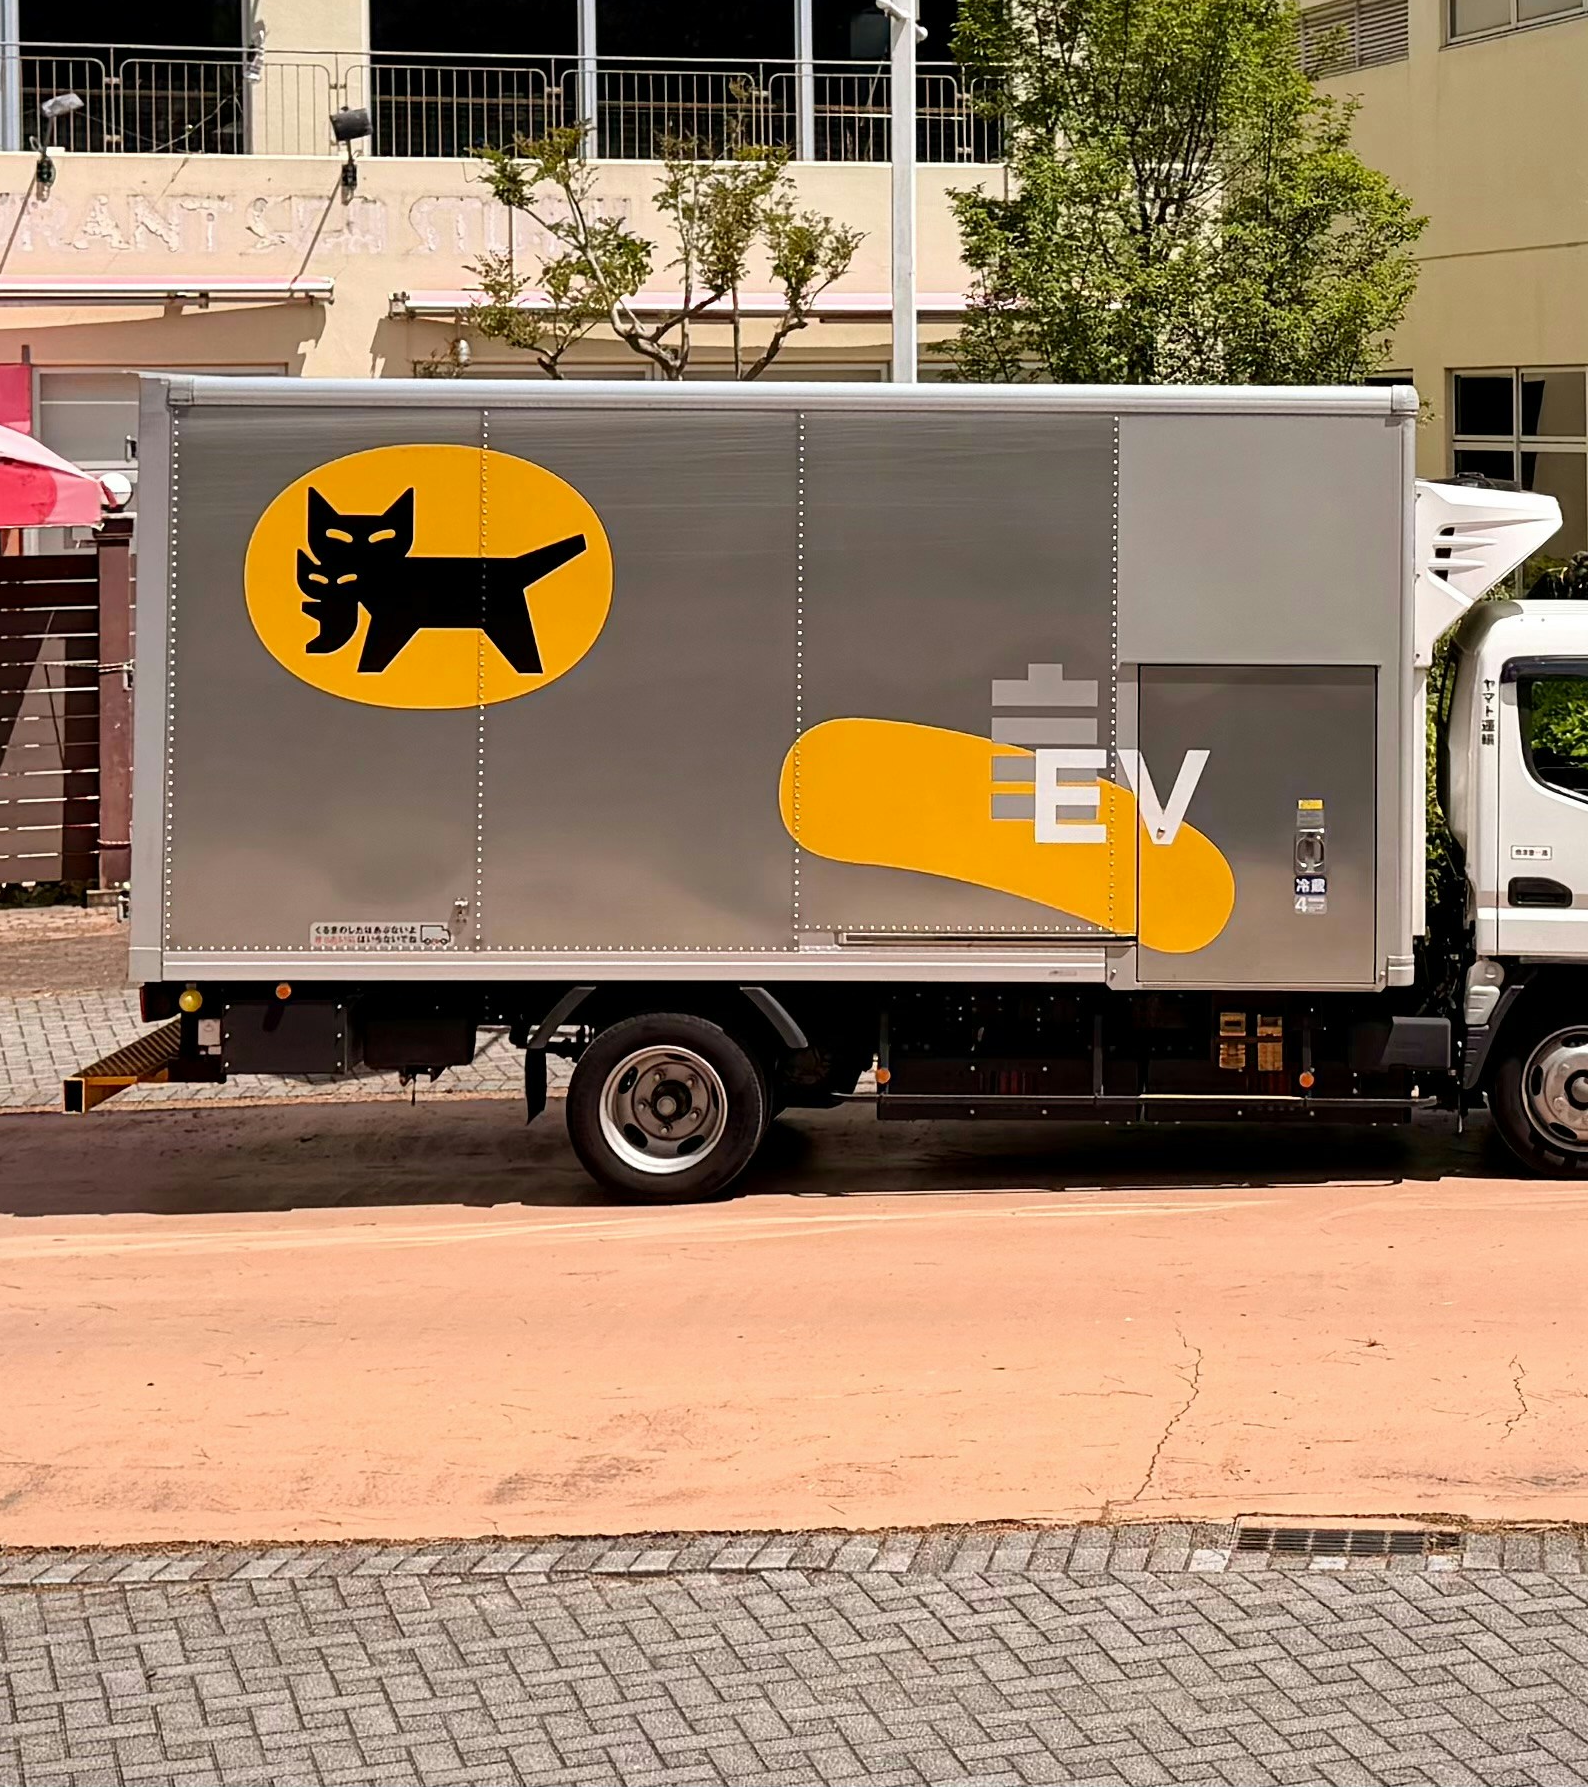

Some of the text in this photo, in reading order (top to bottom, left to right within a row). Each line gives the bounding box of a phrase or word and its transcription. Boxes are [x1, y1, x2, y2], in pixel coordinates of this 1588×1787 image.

[1481, 677, 1496, 746] ヤマト運輸
[1035, 748, 1211, 845] EV
[1295, 877, 1326, 893] 冷蔵
